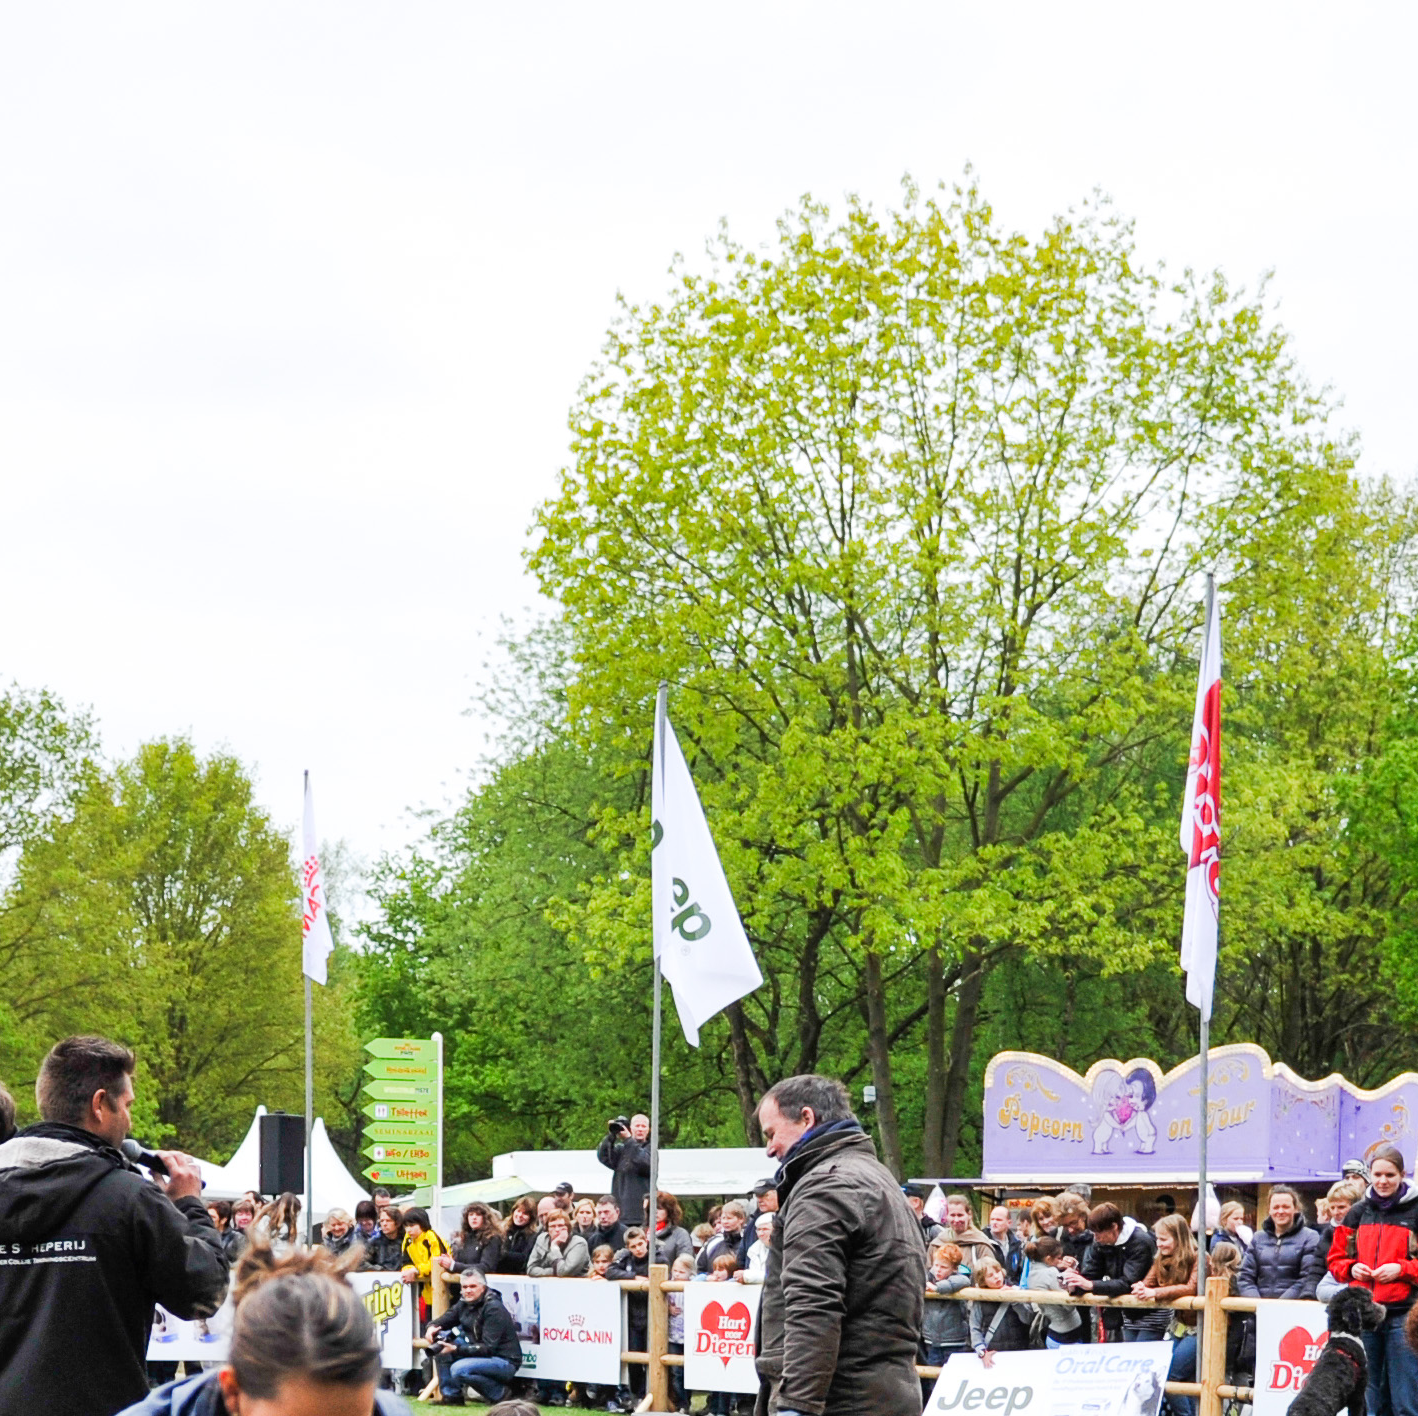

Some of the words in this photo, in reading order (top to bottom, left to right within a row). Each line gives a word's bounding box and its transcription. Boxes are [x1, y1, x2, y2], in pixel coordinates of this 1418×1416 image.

[998, 1094, 1084, 1142] Popcorn
[1167, 1116, 1193, 1141] on
[1205, 1098, 1256, 1136] Tour
[718, 1316, 747, 1330] Hart
[543, 1327, 575, 1342] ROYAL
[578, 1330, 613, 1344] CANIN
[694, 1332, 757, 1355] Dieren
[937, 1380, 1034, 1416] Jeep
